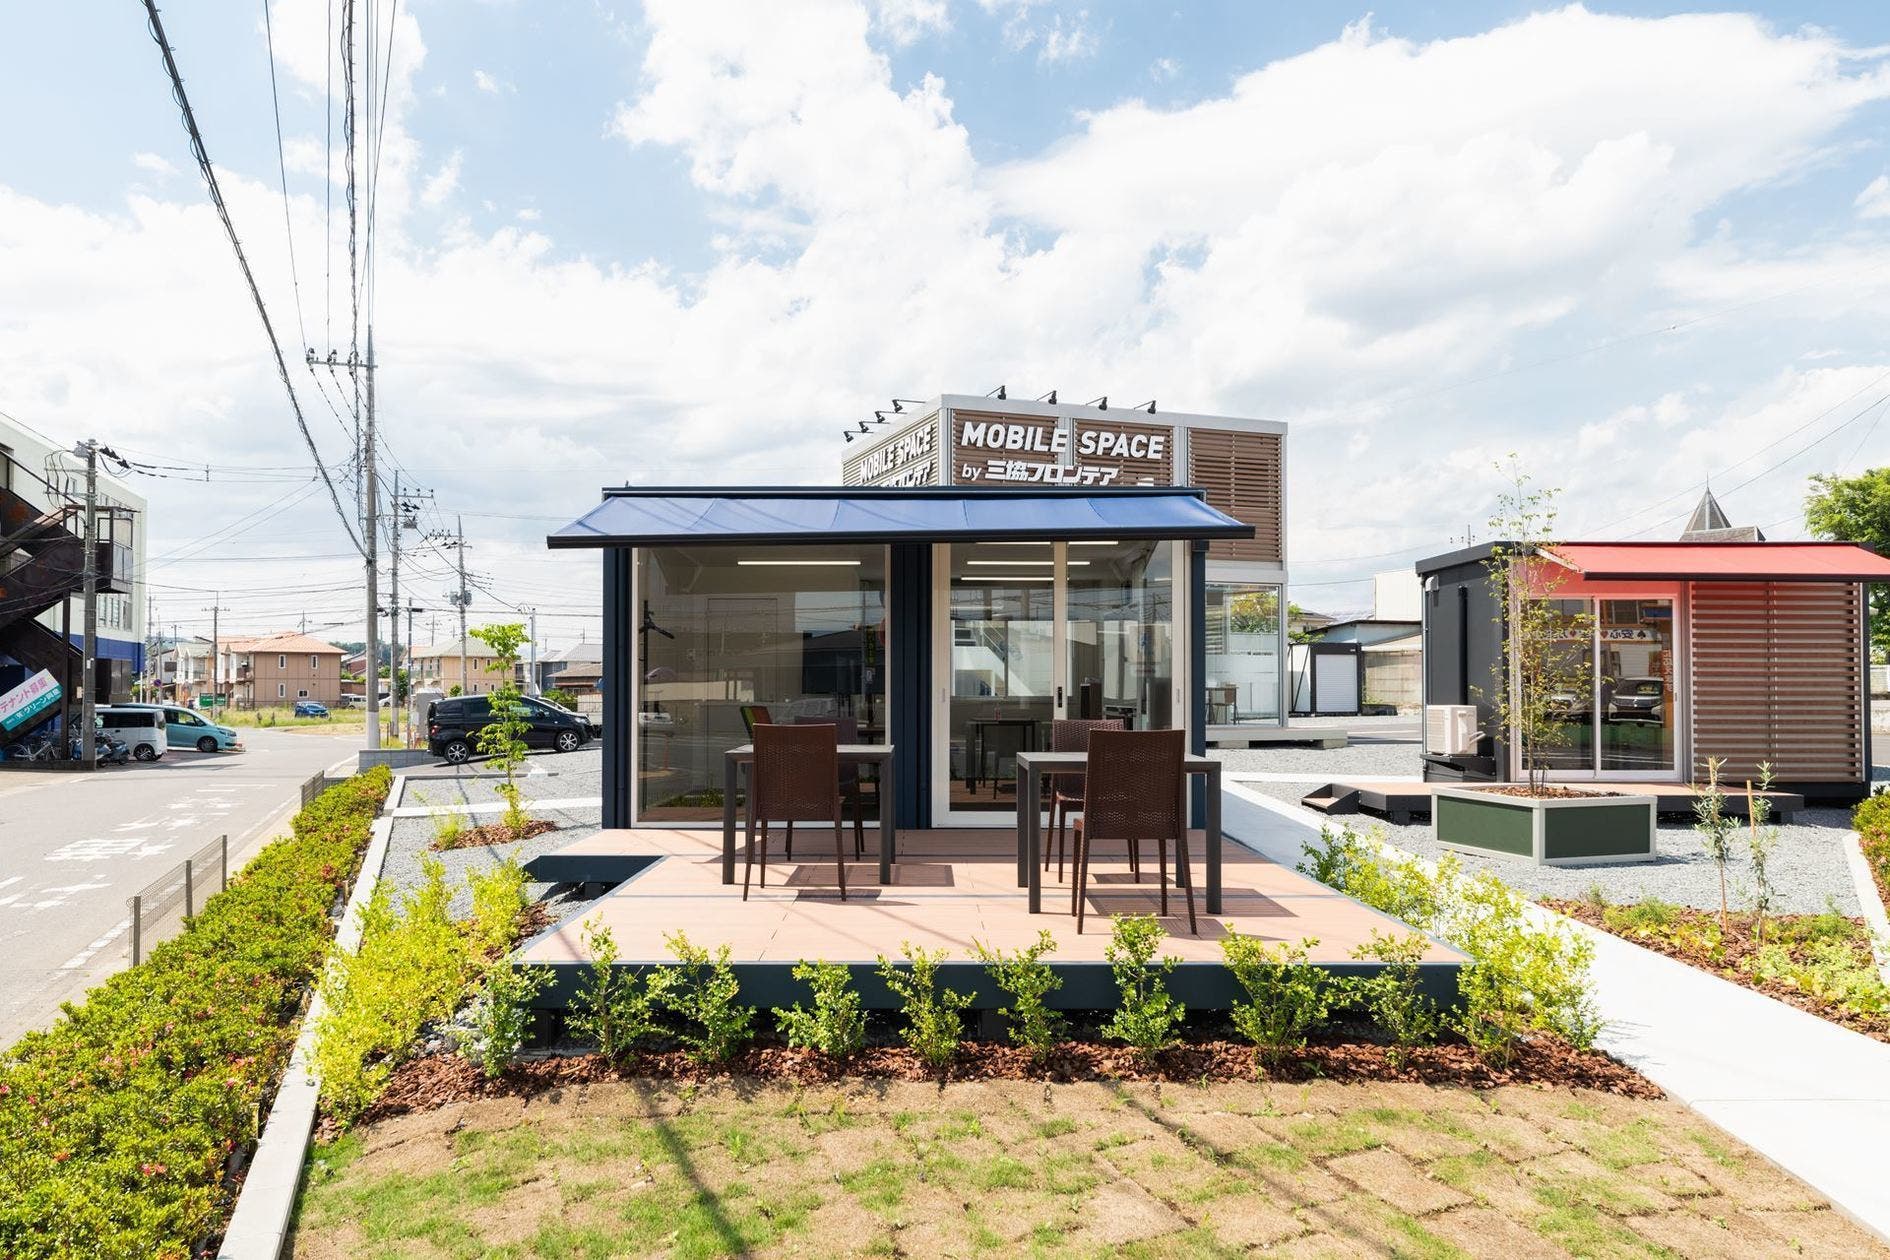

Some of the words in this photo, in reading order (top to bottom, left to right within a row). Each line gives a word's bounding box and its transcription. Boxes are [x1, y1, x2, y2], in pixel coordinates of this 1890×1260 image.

[861, 444, 895, 483] MOBILE
[896, 425, 931, 465] SPACE
[961, 422, 1068, 452] MOBILE
[1079, 431, 1165, 459] SPACE
[961, 464, 982, 480] by
[985, 460, 1119, 485] 三協フロンテア
